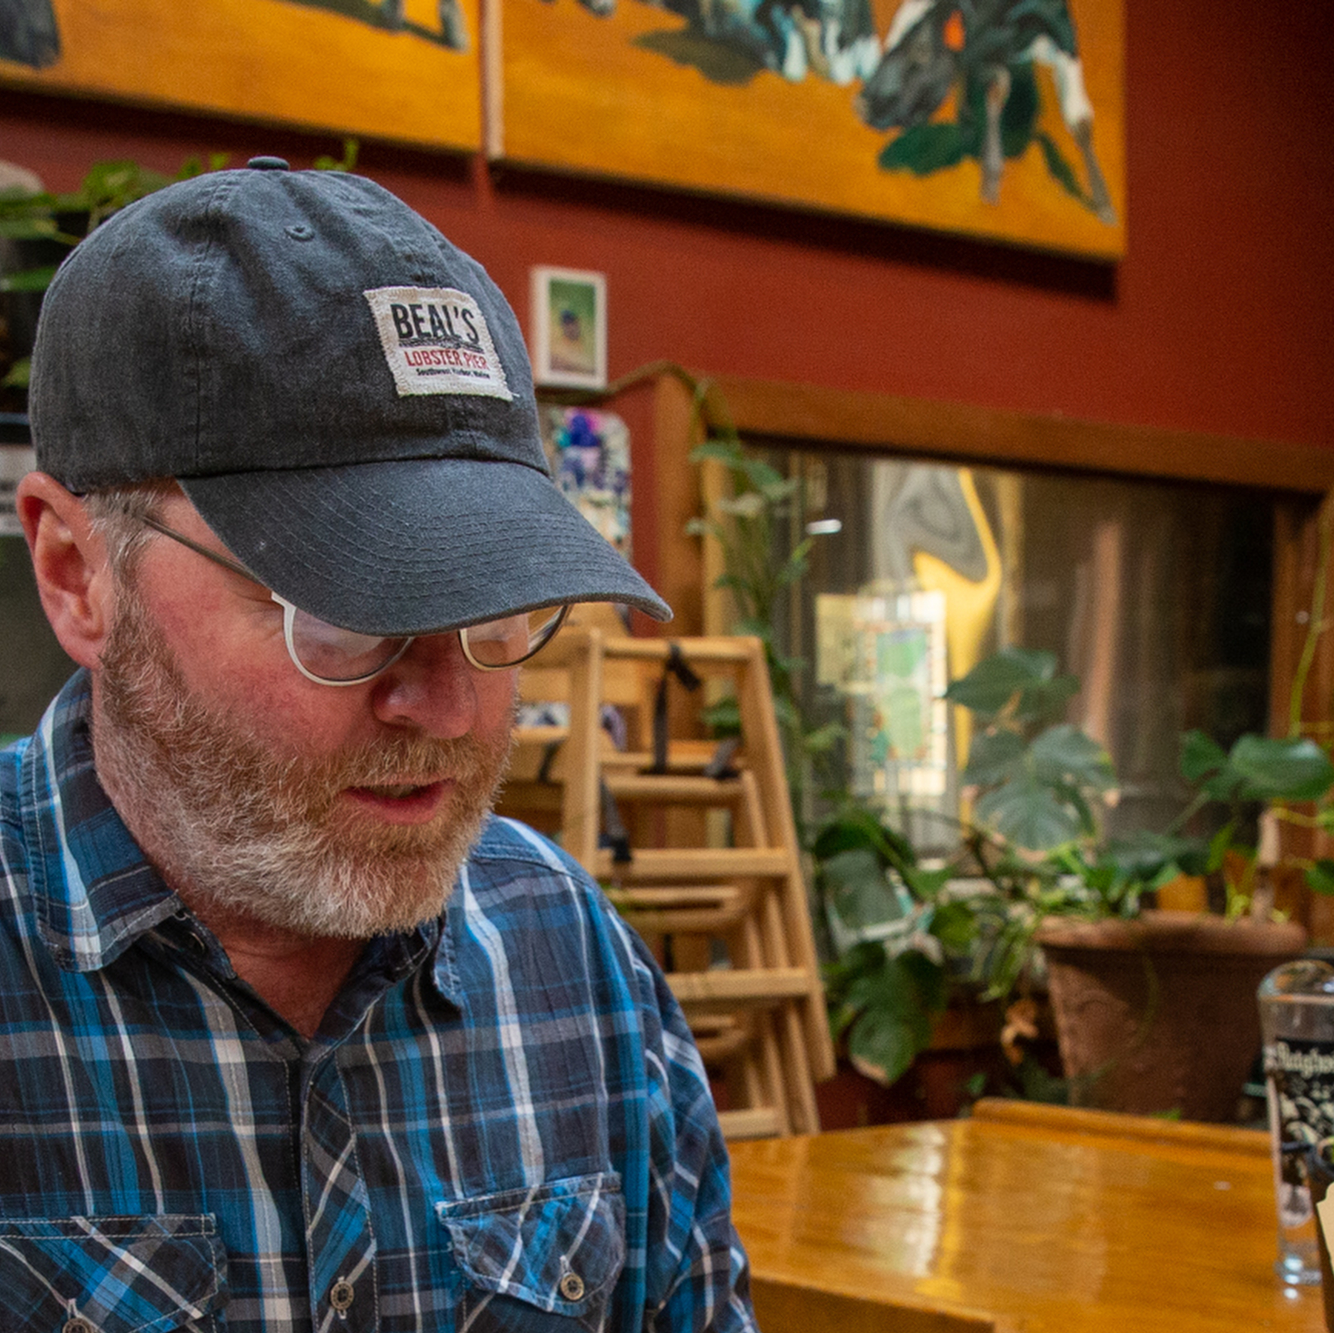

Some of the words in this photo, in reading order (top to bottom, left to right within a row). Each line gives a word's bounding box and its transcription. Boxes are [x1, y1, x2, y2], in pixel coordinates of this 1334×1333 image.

[389, 303, 480, 346] BEAL'S
[404, 350, 464, 368] LOBSTER
[463, 351, 491, 371] PIER
